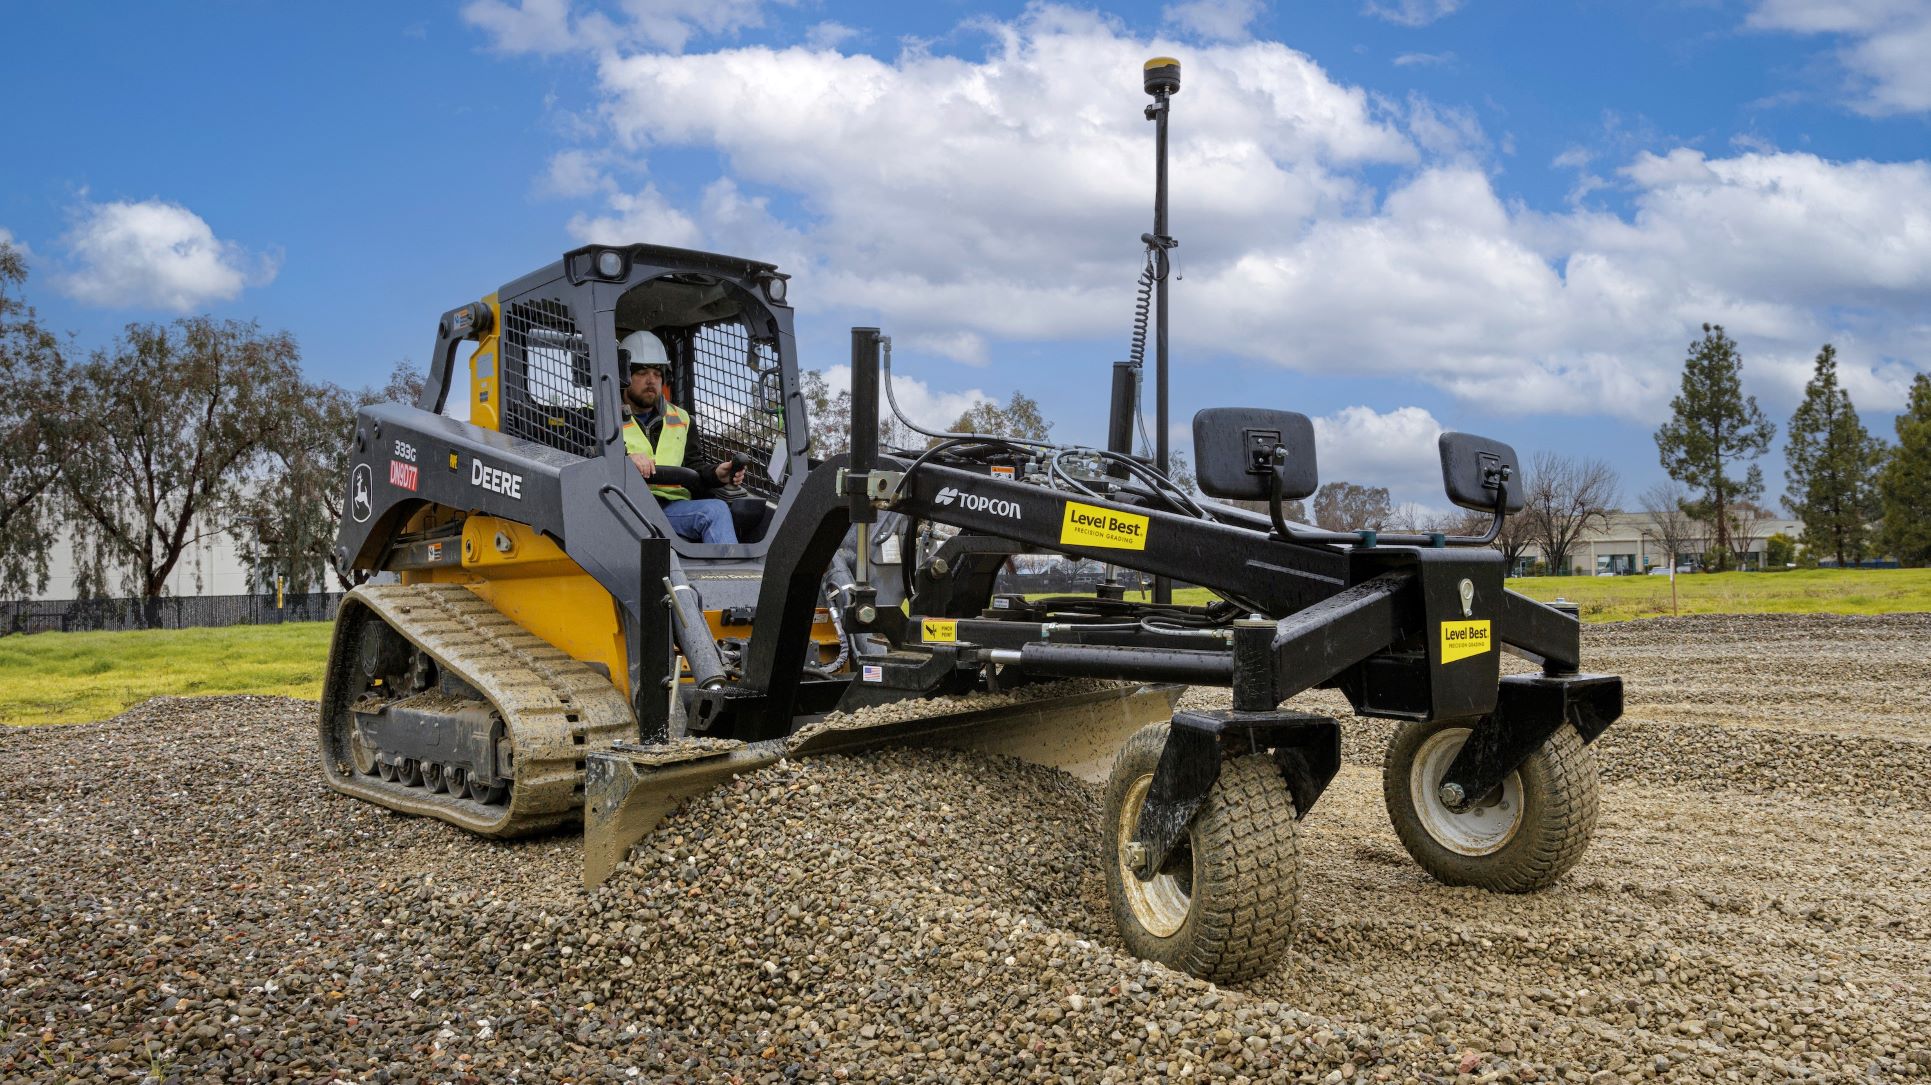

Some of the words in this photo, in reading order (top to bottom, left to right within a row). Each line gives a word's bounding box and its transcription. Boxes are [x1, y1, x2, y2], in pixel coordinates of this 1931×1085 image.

[394, 440, 417, 462] 333G
[471, 458, 523, 500] DEERE
[958, 492, 1022, 520] TOPCON
[1070, 509, 1107, 529] Level
[1108, 517, 1141, 537] Best
[1074, 526, 1105, 539] PRECISION
[1105, 533, 1134, 544] GRADING
[1445, 627, 1468, 641] Level
[1469, 626, 1488, 639] Best
